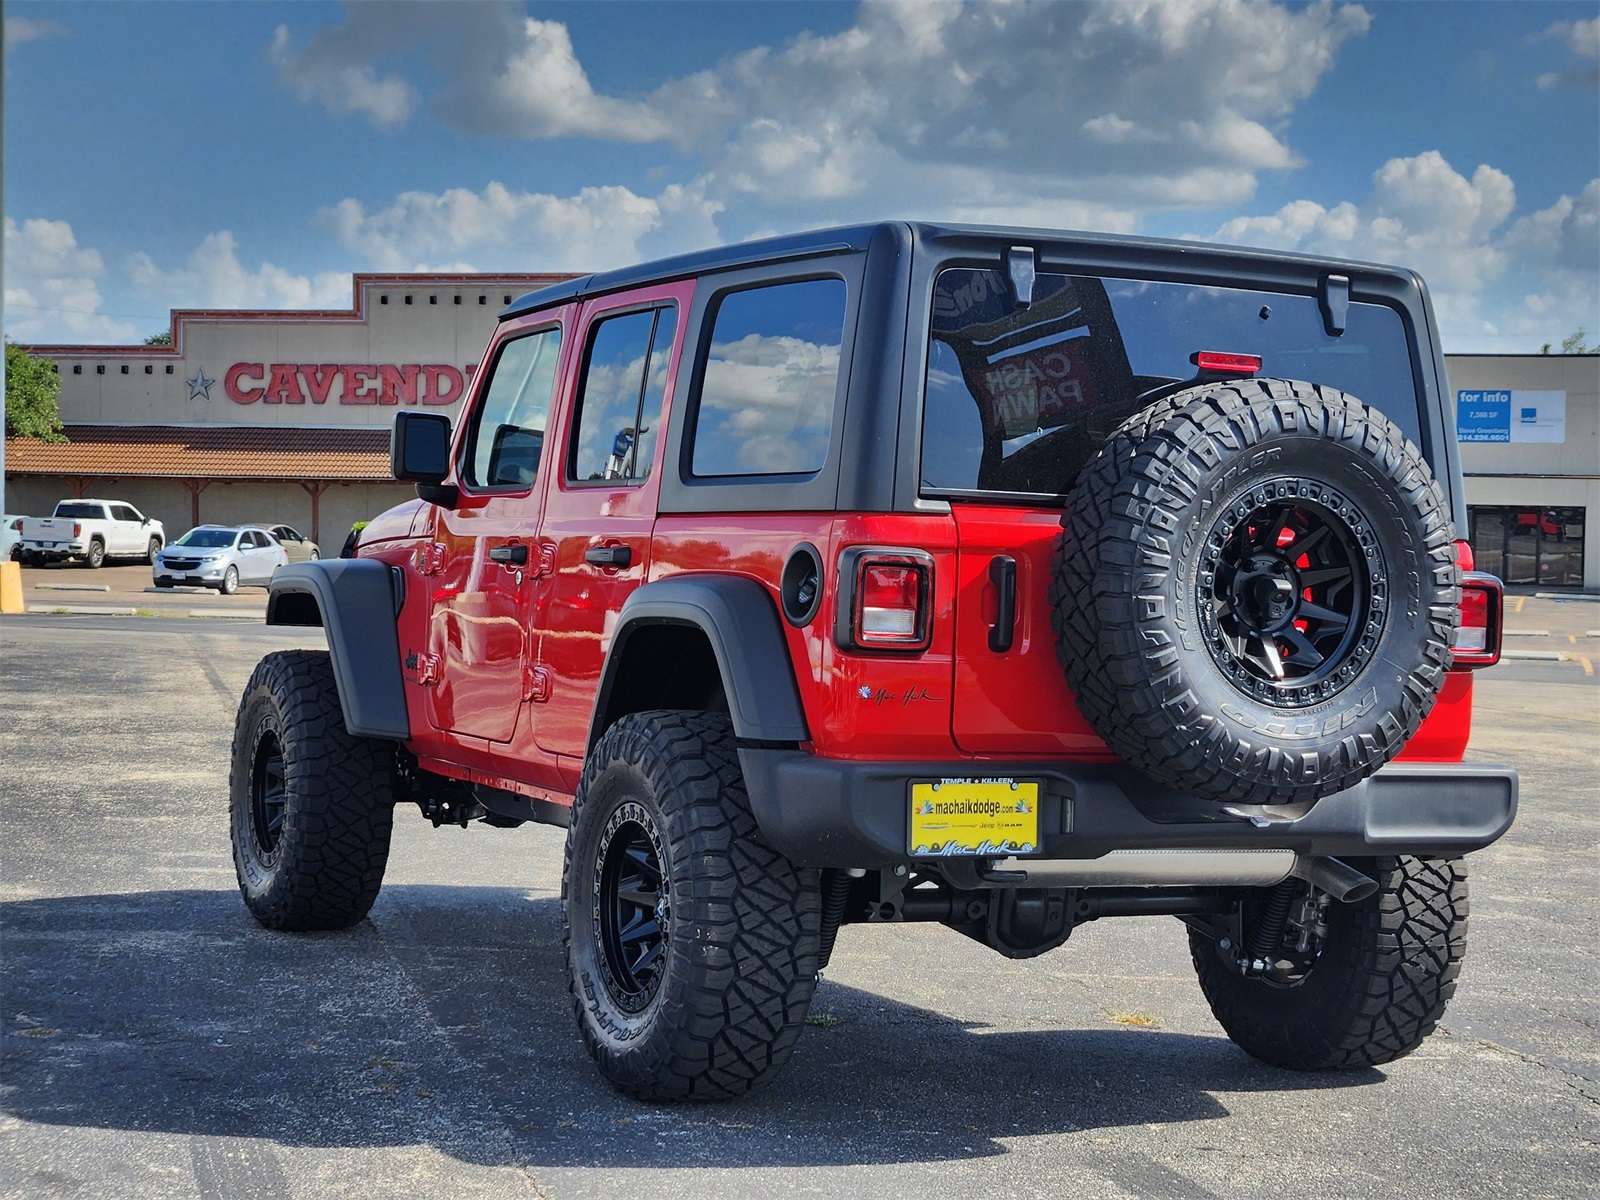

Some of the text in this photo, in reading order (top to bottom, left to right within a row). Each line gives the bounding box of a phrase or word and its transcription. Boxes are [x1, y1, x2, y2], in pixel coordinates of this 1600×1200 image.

[1460, 392, 1509, 403] for info
[935, 799, 1014, 817] machaikdodge.com
[941, 839, 1015, 856] Mac Haik
